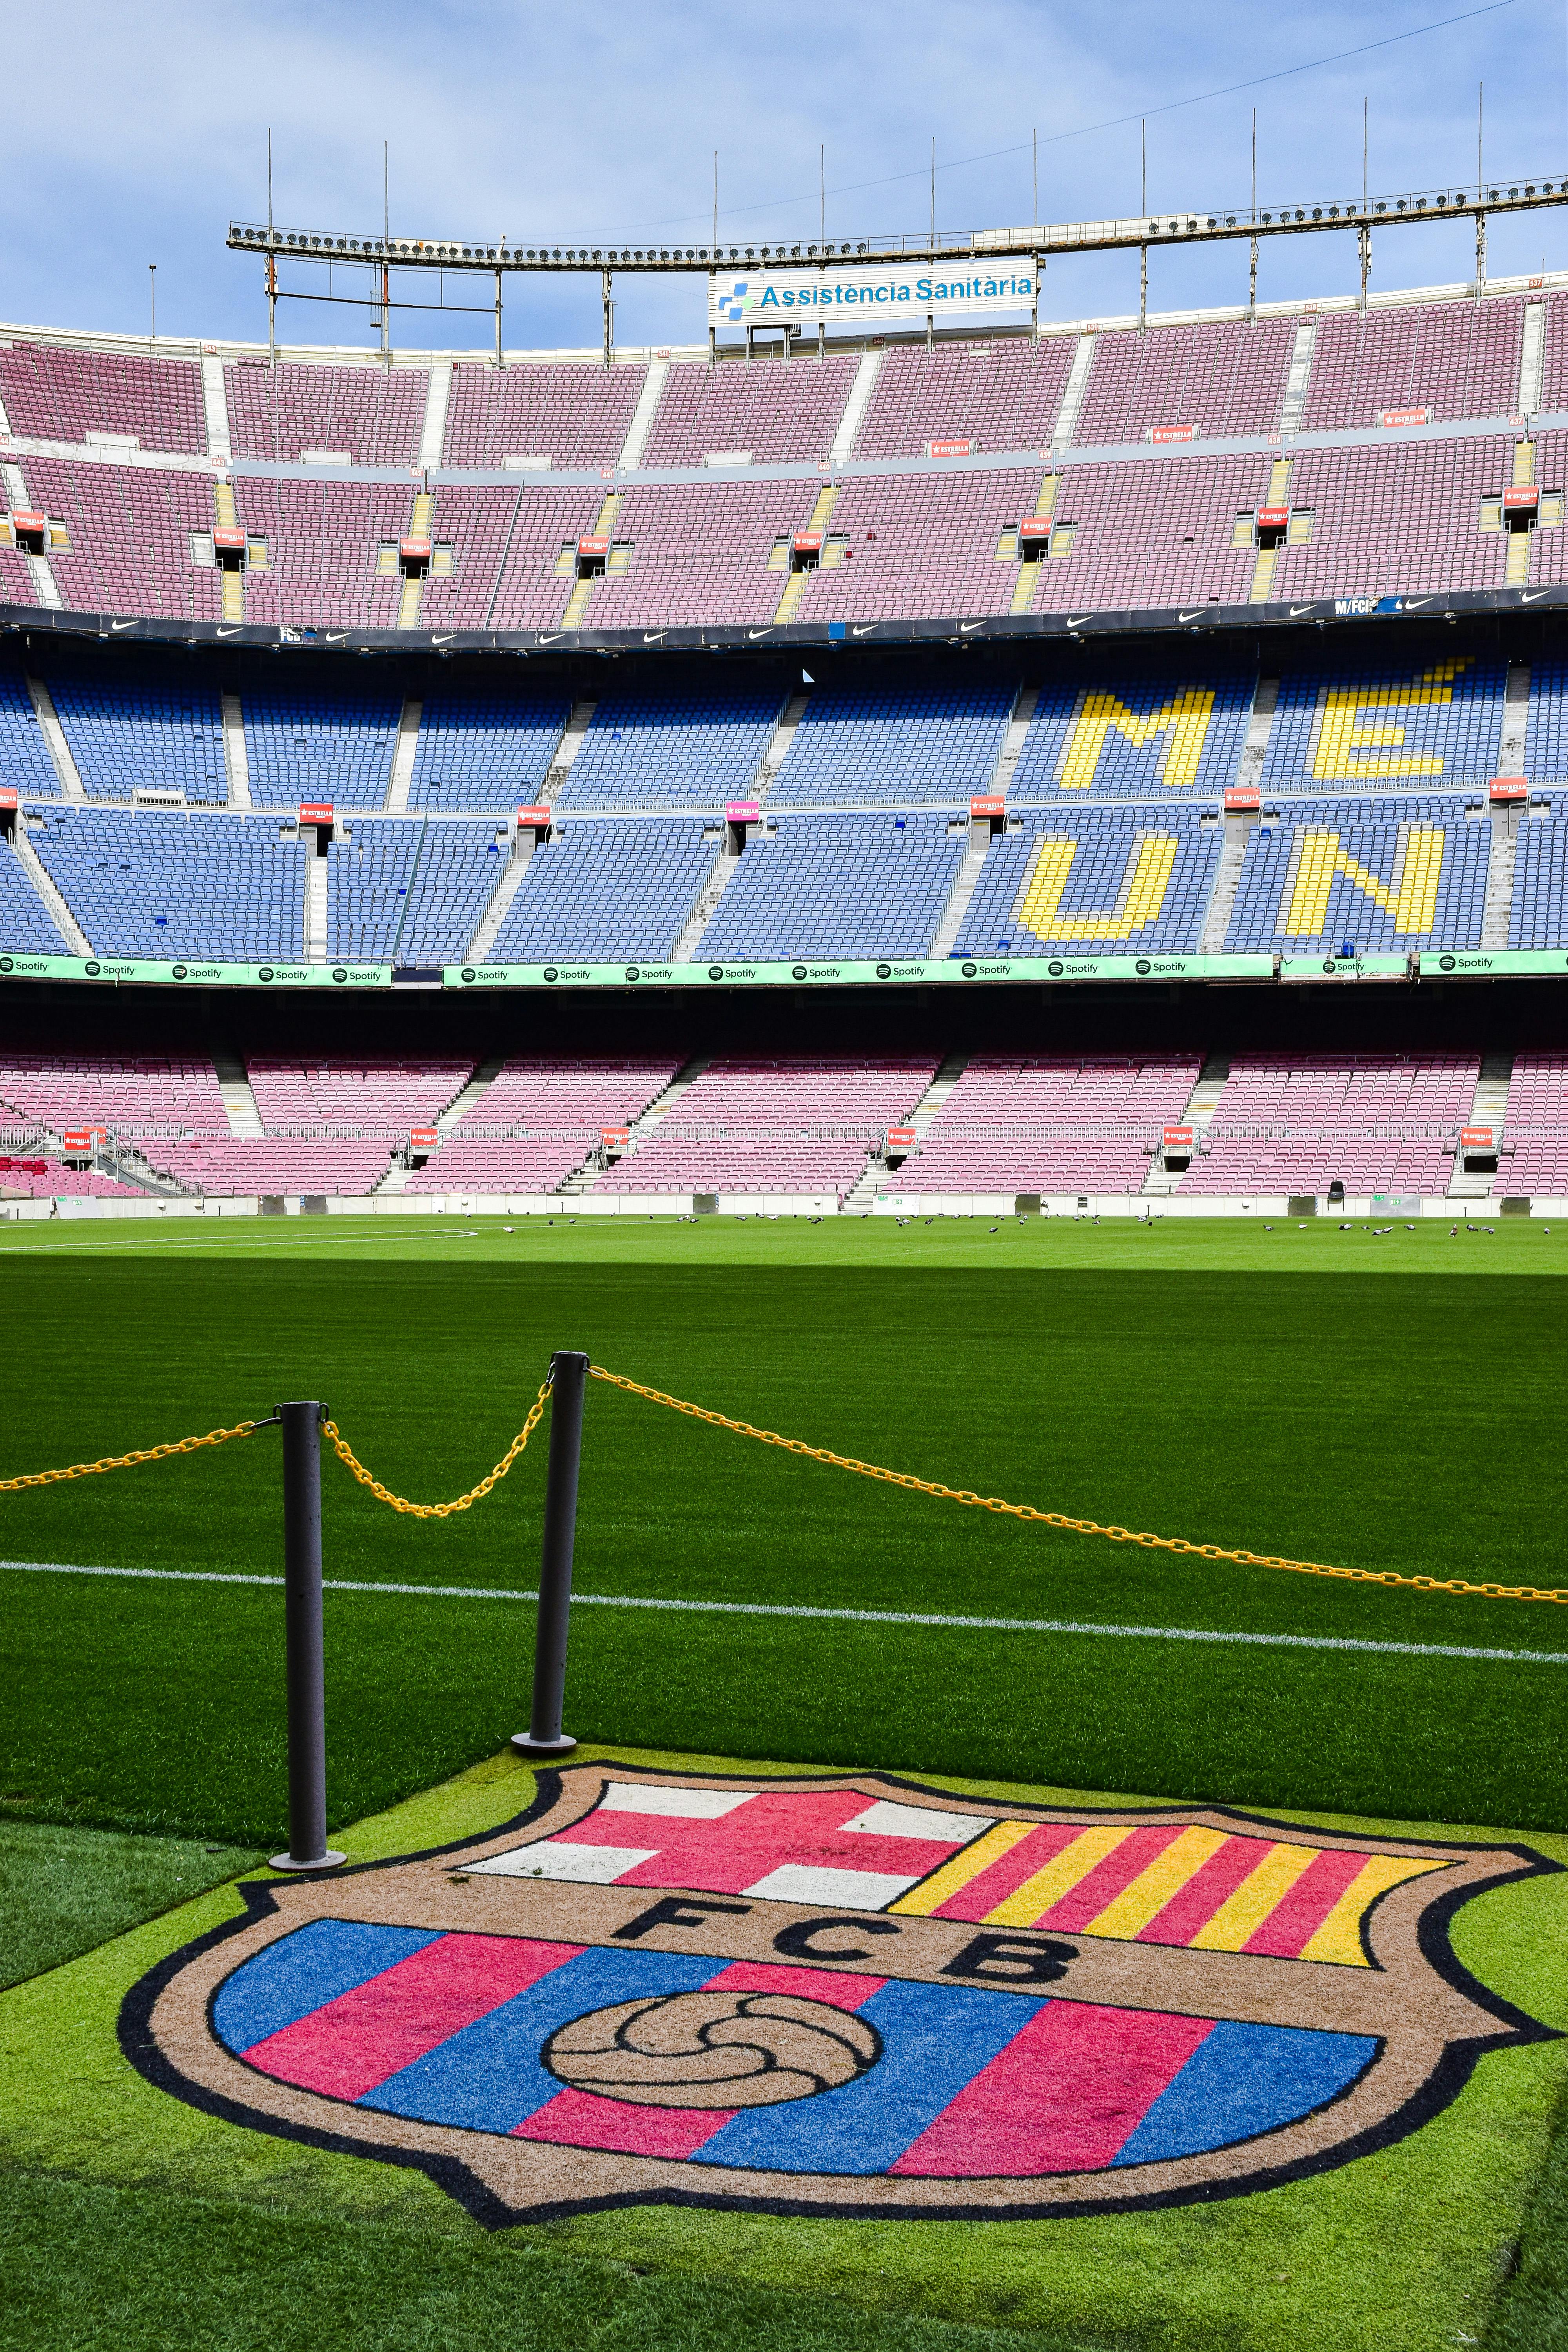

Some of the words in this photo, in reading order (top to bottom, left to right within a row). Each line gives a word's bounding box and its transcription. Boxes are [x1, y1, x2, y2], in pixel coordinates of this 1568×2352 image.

[761, 281, 910, 308] Assistència
[916, 275, 1031, 300] Sanitària
[1394, 414, 1425, 423] ESTRELLA
[1509, 417, 1523, 426] 437
[16, 962, 48, 971] Spotify
[1153, 962, 1186, 972] Spotify
[1338, 962, 1364, 971] Spotify
[1458, 958, 1493, 968] Spotify
[103, 965, 135, 975] Spotify
[190, 969, 221, 978] Spotify
[642, 969, 672, 979] Spotify
[725, 969, 756, 978] Spotify
[809, 968, 840, 978] Spotify
[893, 967, 925, 976] Spotify
[979, 965, 1011, 975] Spotify
[1066, 964, 1098, 974] Spotify
[276, 970, 308, 980] Spotify
[350, 971, 381, 981] Spotify
[478, 970, 508, 980] Spotify
[560, 970, 590, 980] Spotify
[610, 1896, 1080, 1984] FCB
